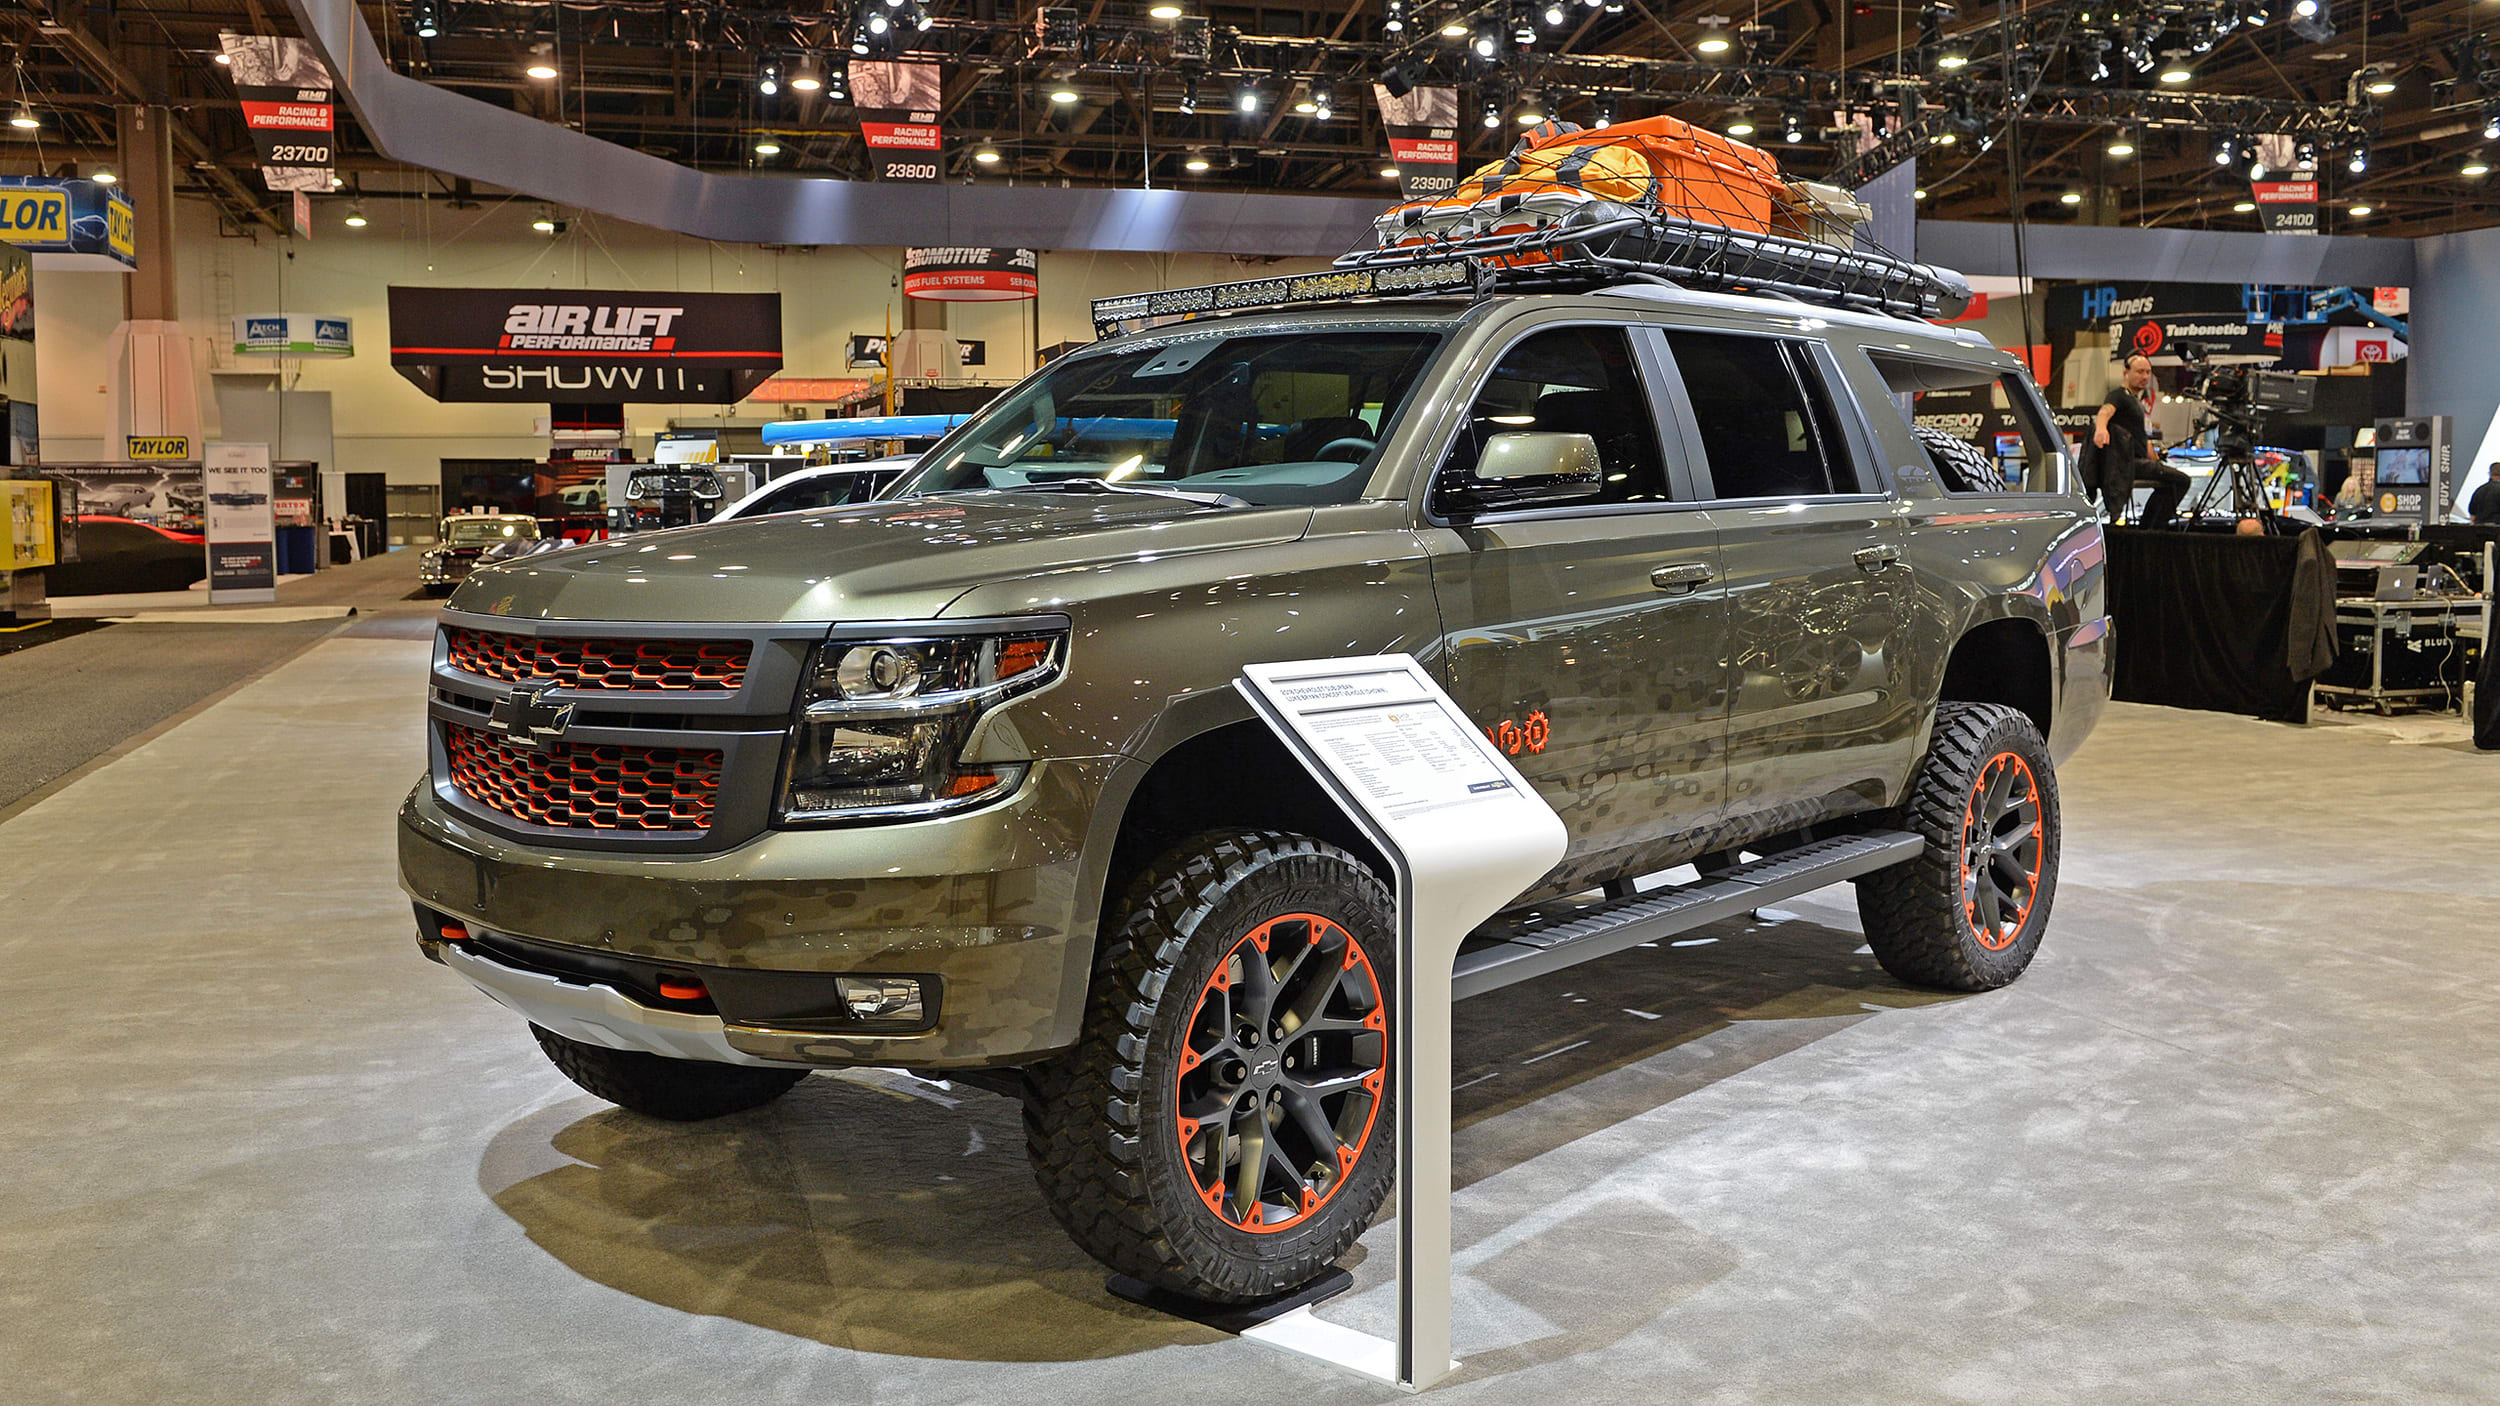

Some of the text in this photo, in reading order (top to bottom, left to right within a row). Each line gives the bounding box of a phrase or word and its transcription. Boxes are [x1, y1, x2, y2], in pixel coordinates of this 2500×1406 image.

[279, 107, 327, 117] RACING &
[253, 115, 328, 127] PERFORMANCE
[894, 128, 927, 137] RACING
[871, 135, 936, 146] PERFORMANCE
[271, 145, 328, 162] 23700
[1417, 143, 1446, 152] RACING
[1398, 151, 1453, 160] PERFORMANCE
[886, 163, 936, 179] 23800
[1410, 177, 1453, 189] 23900
[2260, 192, 2314, 201] PERFORMANCE
[2276, 213, 2314, 227] 24100
[921, 277, 941, 286] FUEL
[942, 275, 985, 286] SYSTEMS
[2083, 286, 2154, 319] HP tuners
[591, 306, 684, 337] LIFT
[2166, 322, 2248, 337] Turbonetics
[510, 335, 653, 351] PERFORMANCE
[131, 440, 186, 456] TAYLOR
[2397, 495, 2422, 505] SHOP
